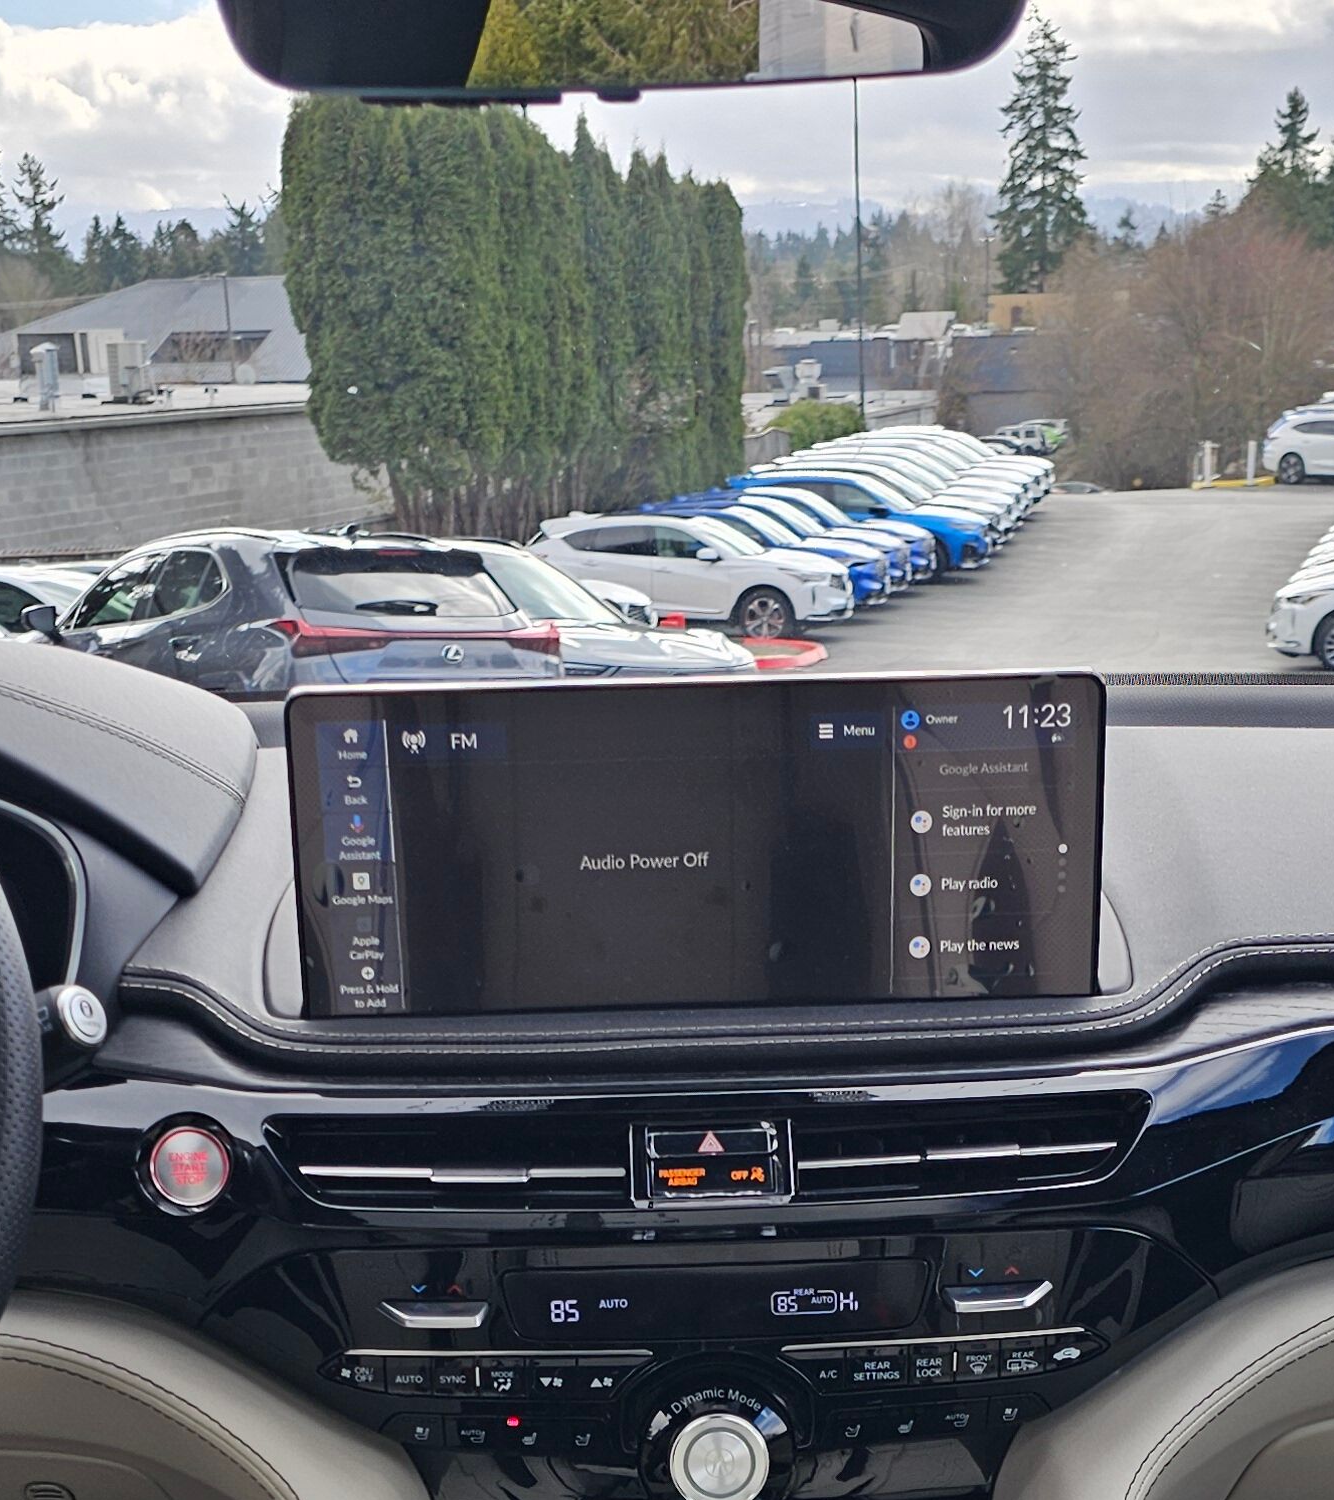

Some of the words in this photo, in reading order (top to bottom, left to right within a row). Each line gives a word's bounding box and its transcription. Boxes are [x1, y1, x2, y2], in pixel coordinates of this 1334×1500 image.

[925, 713, 958, 725] Owner
[1003, 704, 1072, 729] 11:23
[843, 724, 875, 737] Menu
[450, 732, 478, 750] FM
[338, 750, 368, 760] Home
[939, 763, 978, 777] Google
[980, 761, 1029, 775] Assistant
[344, 795, 368, 805] Back
[942, 804, 983, 820] Sign-in
[986, 804, 1003, 817] for
[1005, 805, 1037, 816] more
[942, 823, 990, 837] features
[341, 836, 376, 848] Google
[339, 851, 381, 862] Assistant
[579, 854, 626, 871] Audio
[629, 853, 680, 870] Power
[683, 851, 709, 868] Off
[941, 878, 966, 892] Play
[968, 877, 998, 889] radio
[332, 895, 366, 906] Google
[368, 895, 394, 906] Maps
[352, 936, 380, 947] Apple
[940, 940, 964, 954] Play
[967, 939, 987, 951] the
[988, 940, 1020, 951] news
[349, 950, 385, 961] CarPlay
[339, 985, 364, 995] Press
[366, 985, 375, 994] &
[376, 984, 399, 994] Hold
[355, 999, 365, 1008] to
[367, 999, 386, 1008] Add
[731, 1170, 748, 1180] OFF
[793, 1288, 815, 1297] REAR
[777, 1297, 798, 1312] 85
[811, 1296, 833, 1305] AUTO
[550, 1299, 580, 1323] 85
[599, 1298, 628, 1310] AUTO
[966, 1354, 992, 1363] FRONT
[1012, 1351, 1034, 1360] REAR
[864, 1361, 890, 1371] REAR
[916, 1358, 942, 1368] REAR
[491, 1371, 514, 1379] MODE
[819, 1370, 837, 1380] A/C
[853, 1370, 900, 1382] SETTINGS
[916, 1367, 942, 1378] LOCK
[355, 1374, 374, 1383] OFF
[395, 1374, 423, 1384] AUTO
[439, 1374, 466, 1384] SYNC
[670, 1386, 725, 1414] Dynamic
[727, 1388, 762, 1412] Mode
